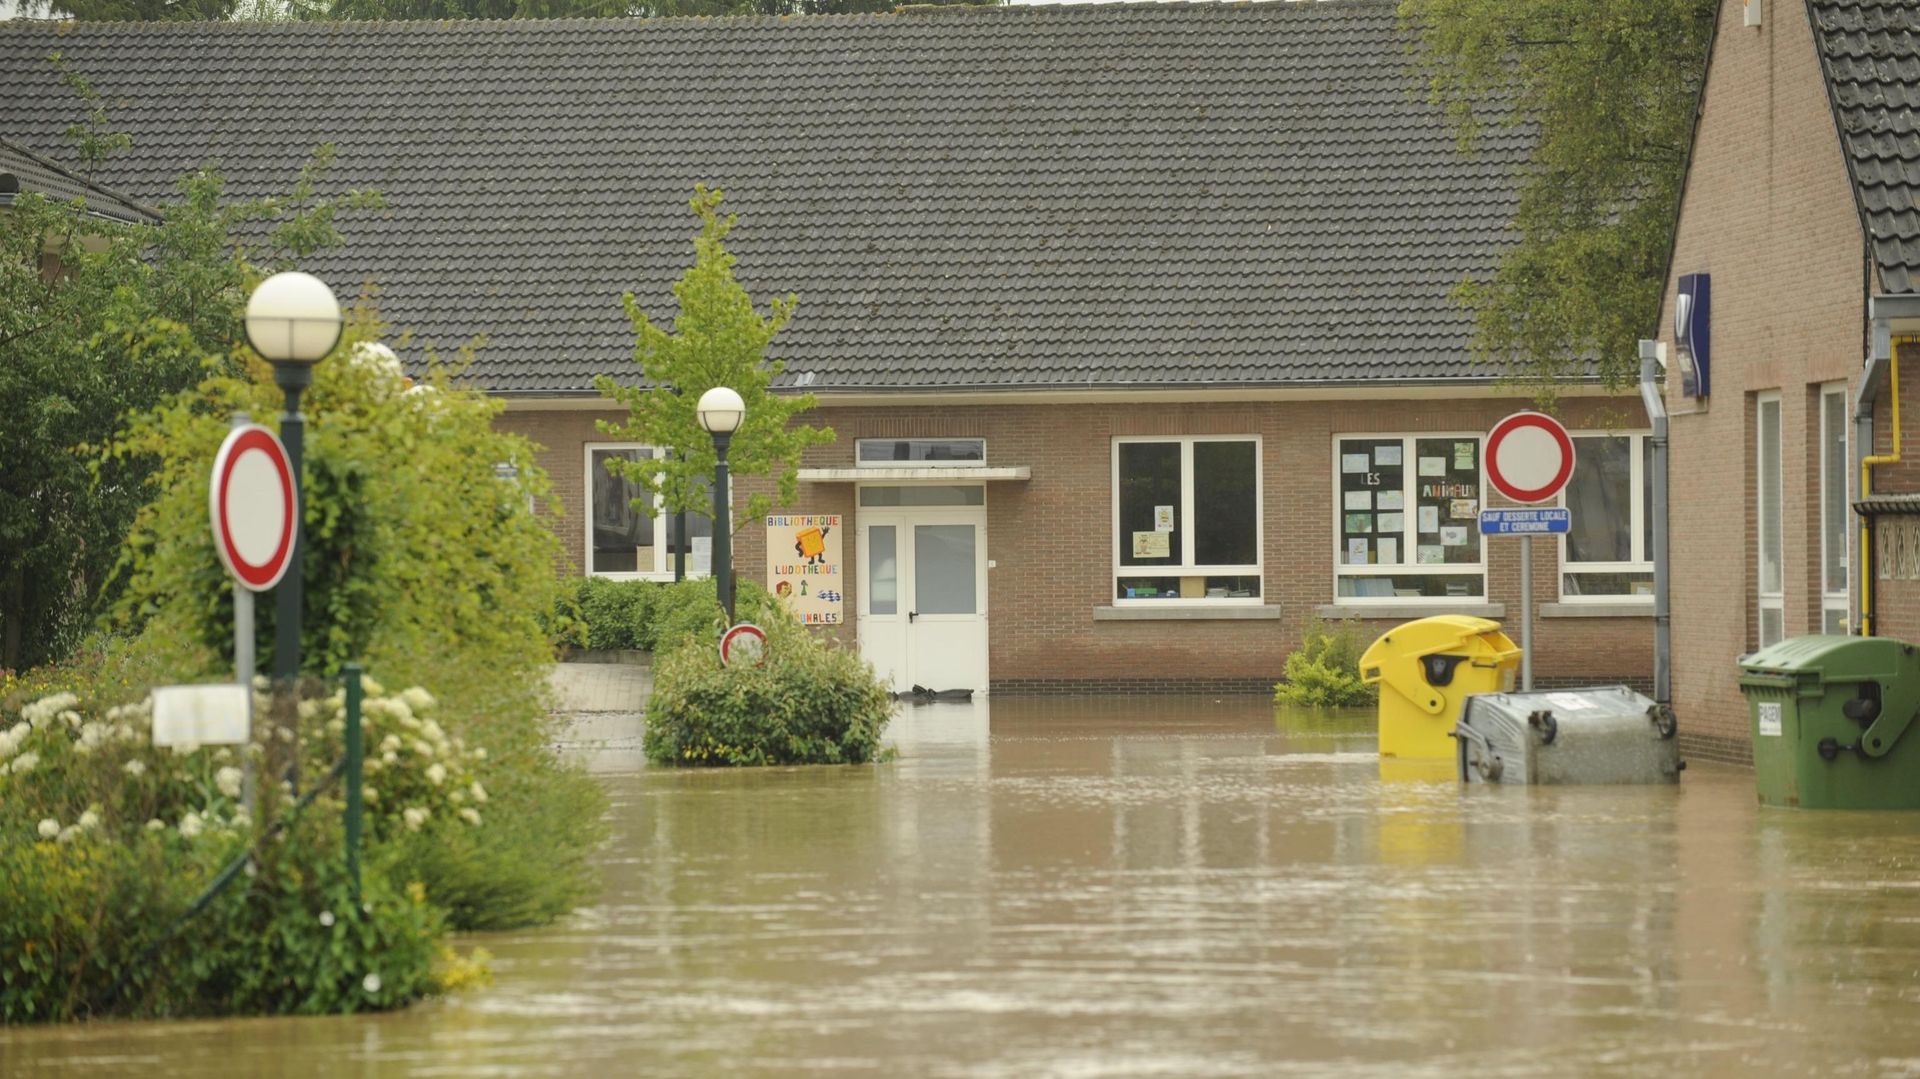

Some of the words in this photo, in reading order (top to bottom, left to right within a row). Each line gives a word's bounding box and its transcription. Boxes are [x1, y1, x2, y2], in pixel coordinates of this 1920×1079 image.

[1361, 472, 1380, 485] LES
[1482, 512, 1500, 522] SAUF
[1503, 511, 1538, 521] DESSERTE
[1540, 510, 1567, 520] LOCALE
[1500, 522, 1509, 531] ET
[775, 565, 838, 575] LUDOTHEQUE
